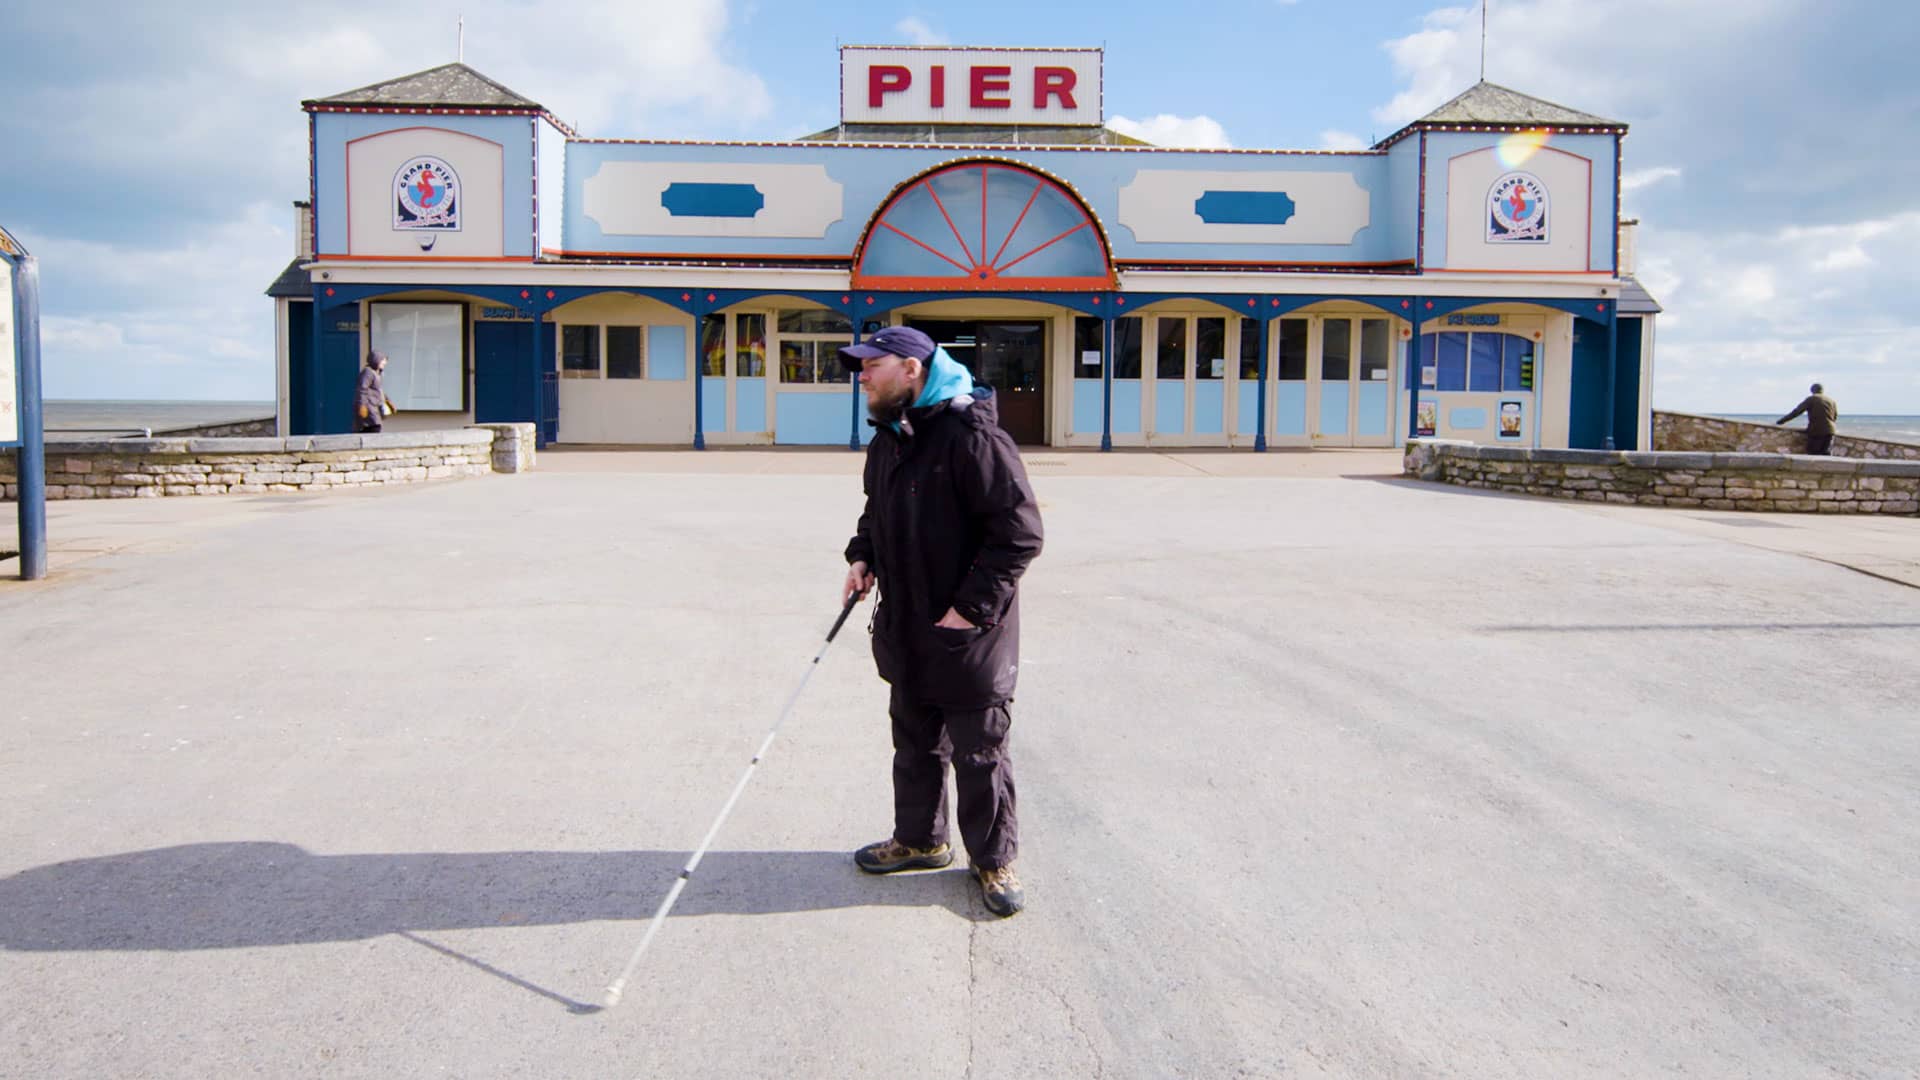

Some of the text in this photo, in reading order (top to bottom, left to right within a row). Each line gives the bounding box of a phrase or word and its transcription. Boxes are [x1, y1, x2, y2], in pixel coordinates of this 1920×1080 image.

[868, 65, 1078, 109] PIER
[400, 163, 453, 190] GRAND PIER
[1494, 178, 1543, 203] GRAND PIER
